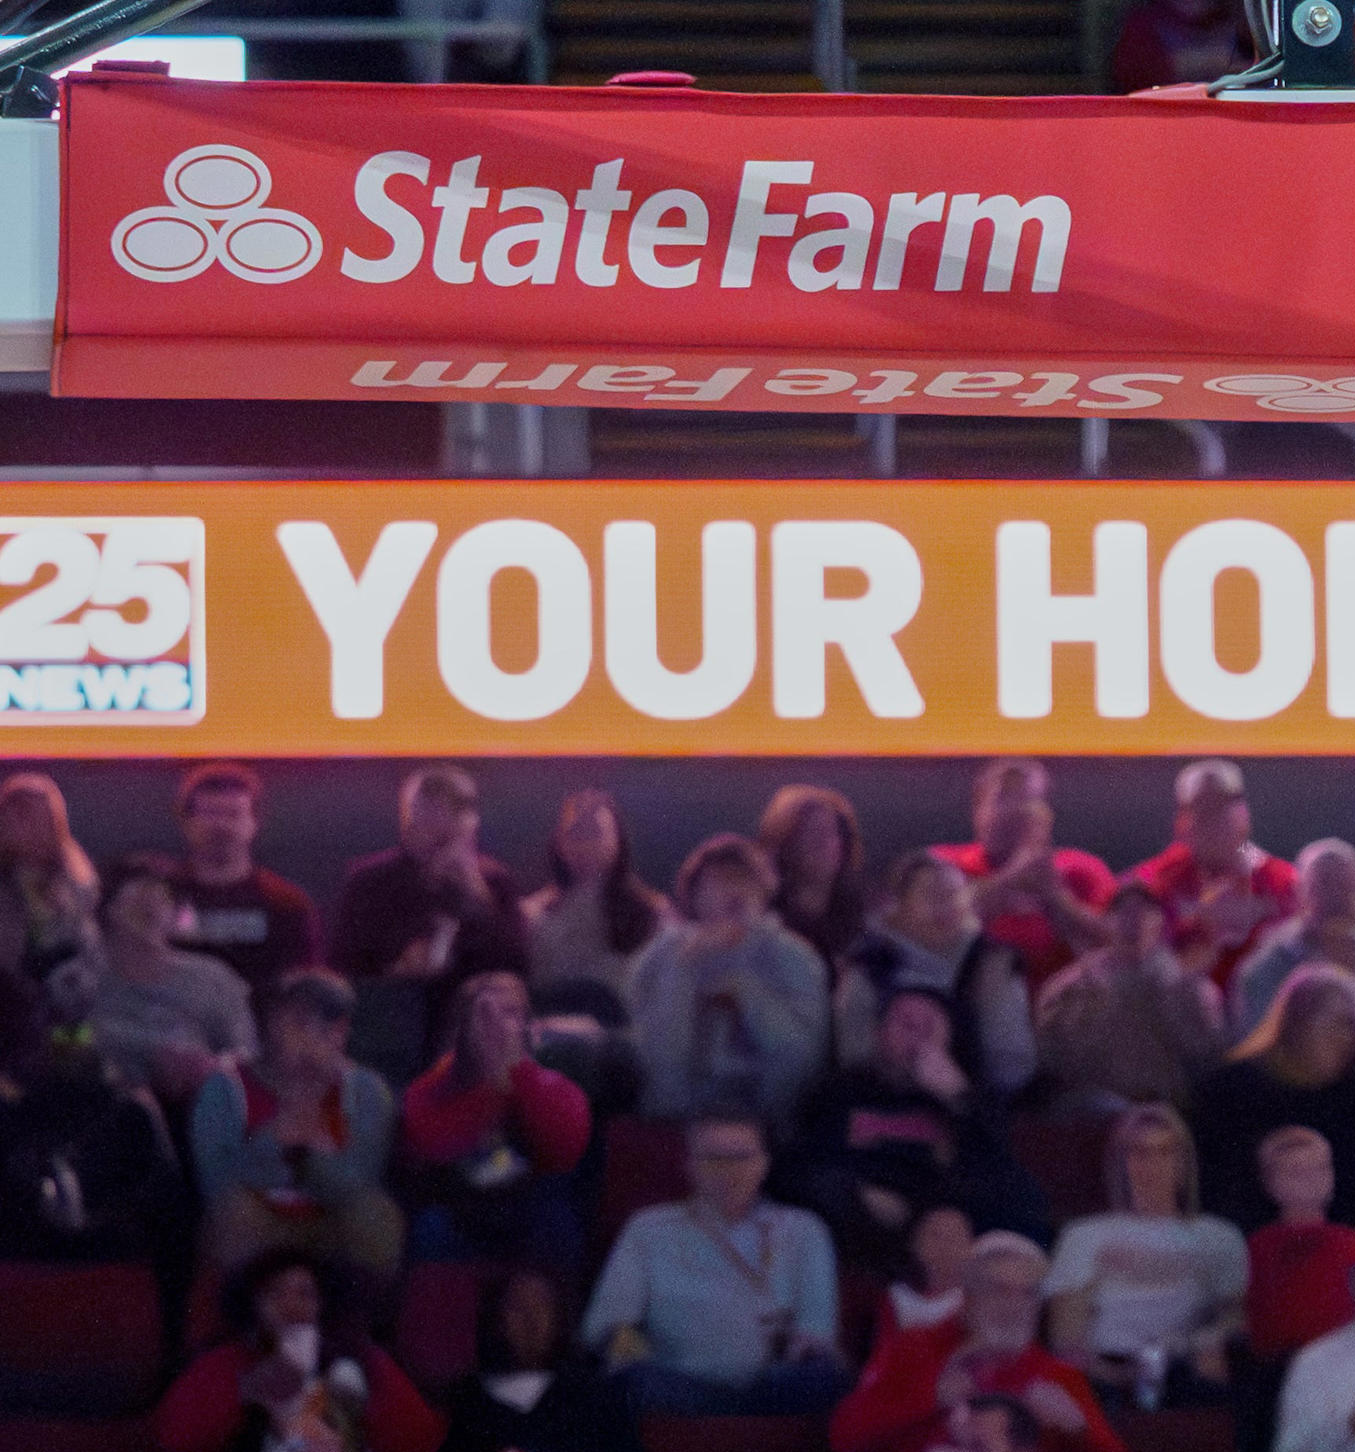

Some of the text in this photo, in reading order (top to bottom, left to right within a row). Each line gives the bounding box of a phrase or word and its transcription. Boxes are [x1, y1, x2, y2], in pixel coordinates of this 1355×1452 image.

[0, 525, 192, 660] 25
[277, 519, 926, 720] YOUR
[0, 663, 192, 711] NEWS
